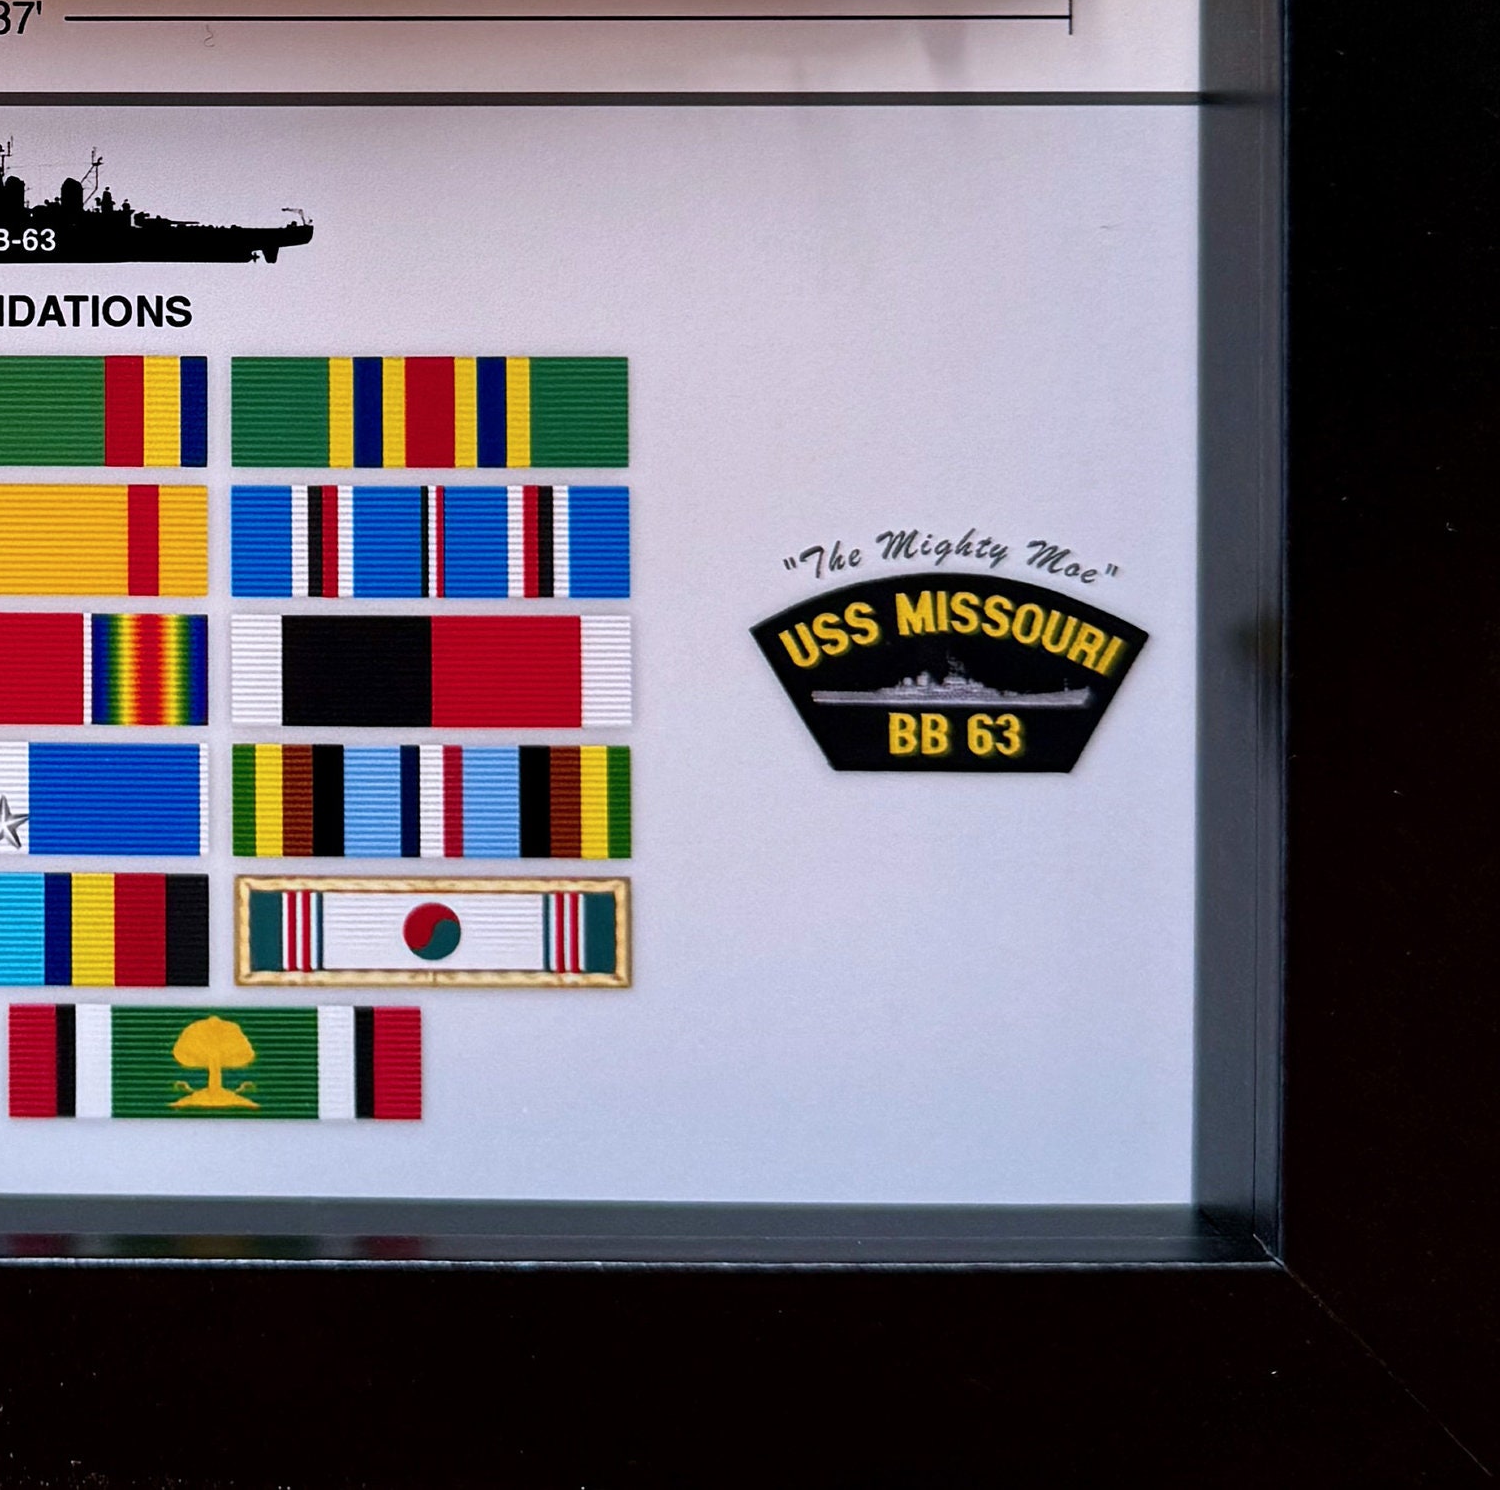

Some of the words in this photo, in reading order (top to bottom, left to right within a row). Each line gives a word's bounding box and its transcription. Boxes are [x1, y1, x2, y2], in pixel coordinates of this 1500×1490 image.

[782, 539, 861, 579] "The
[875, 527, 1009, 570] Mighty
[1026, 539, 1119, 584] Moe"
[778, 601, 880, 668] USS
[894, 590, 1124, 676] MISSOURI
[888, 712, 949, 755] BB
[967, 713, 1021, 756] 63
